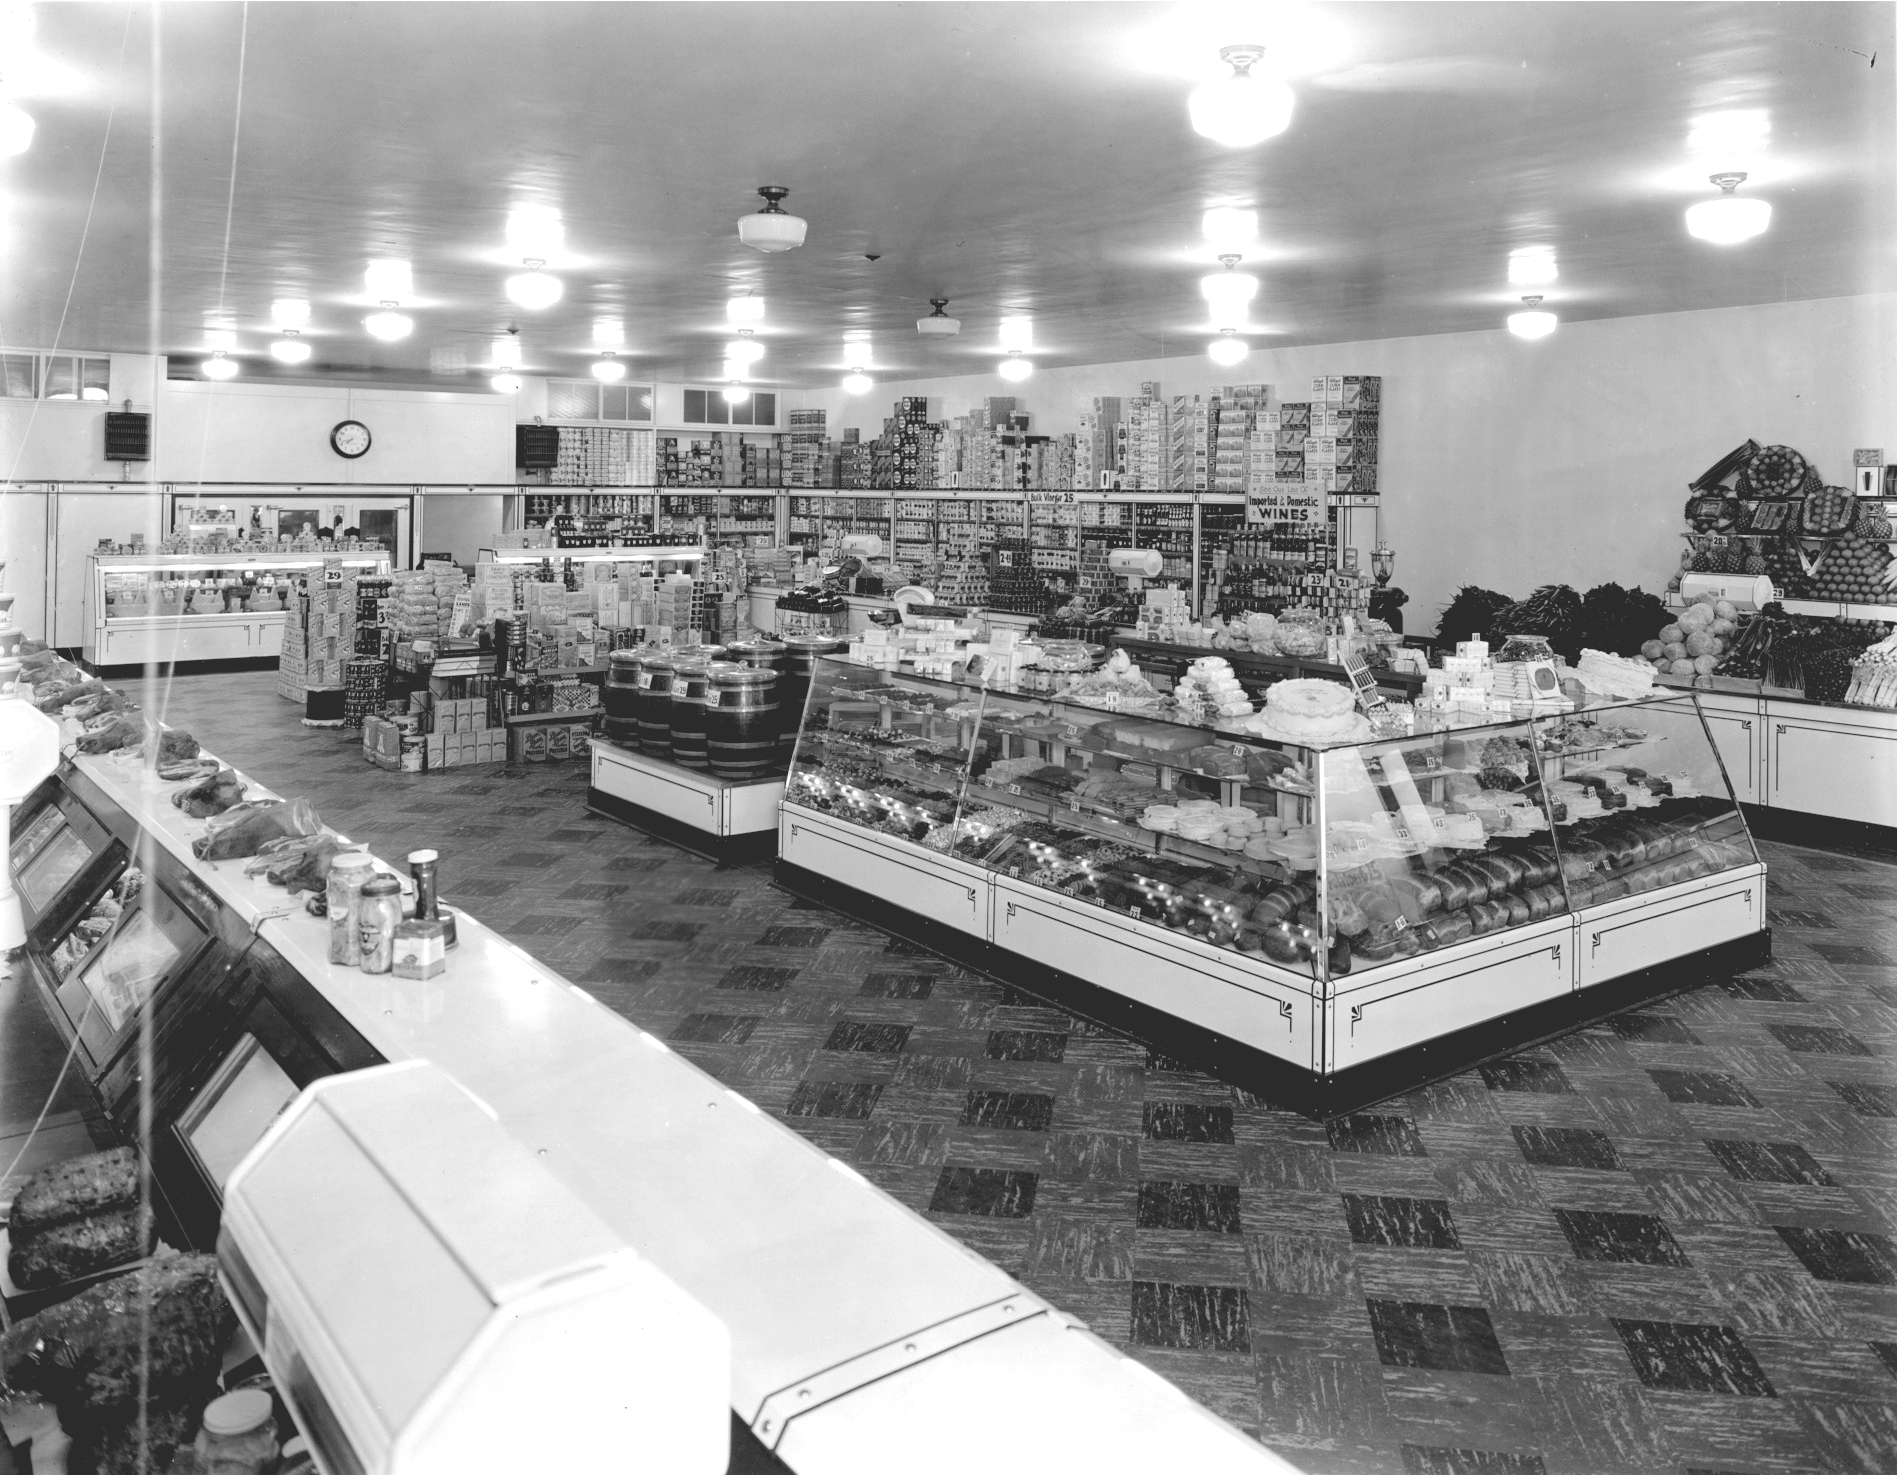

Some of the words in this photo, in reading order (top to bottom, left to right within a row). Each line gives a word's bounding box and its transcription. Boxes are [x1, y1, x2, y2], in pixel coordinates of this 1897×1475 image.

[1031, 493, 1042, 501] Bulk
[1044, 493, 1062, 502] Vinegar
[1064, 493, 1074, 502] 25
[1249, 496, 1277, 507] Imported
[1280, 496, 1284, 506] &
[1287, 496, 1318, 506] Domestic
[1259, 508, 1308, 521] WINES
